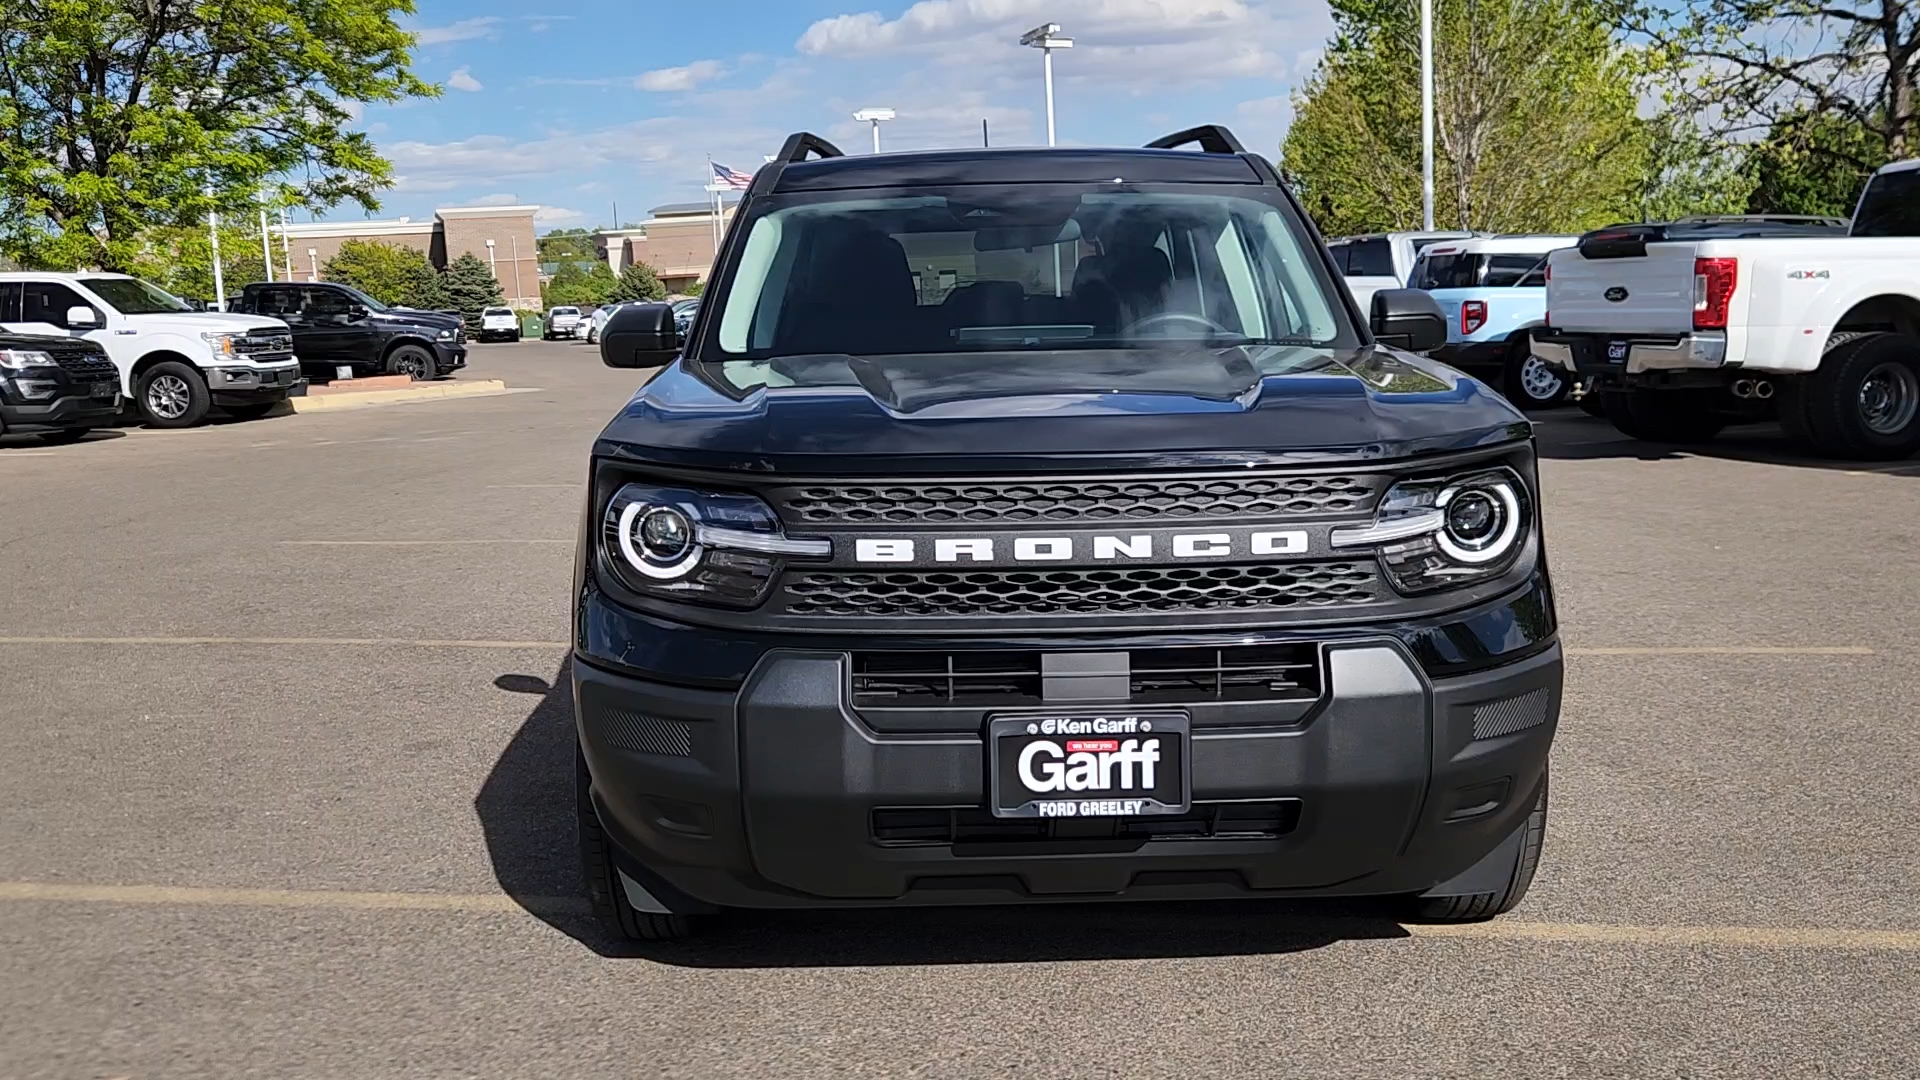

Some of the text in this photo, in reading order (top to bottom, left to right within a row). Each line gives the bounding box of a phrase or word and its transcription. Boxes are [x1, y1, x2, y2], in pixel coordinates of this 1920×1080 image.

[855, 530, 1309, 562] BRONCO
[1057, 718, 1138, 734] Ken Garff
[1100, 743, 1113, 751] you
[1018, 739, 1160, 792] Garff
[1039, 801, 1143, 817] FORD GREELEY
